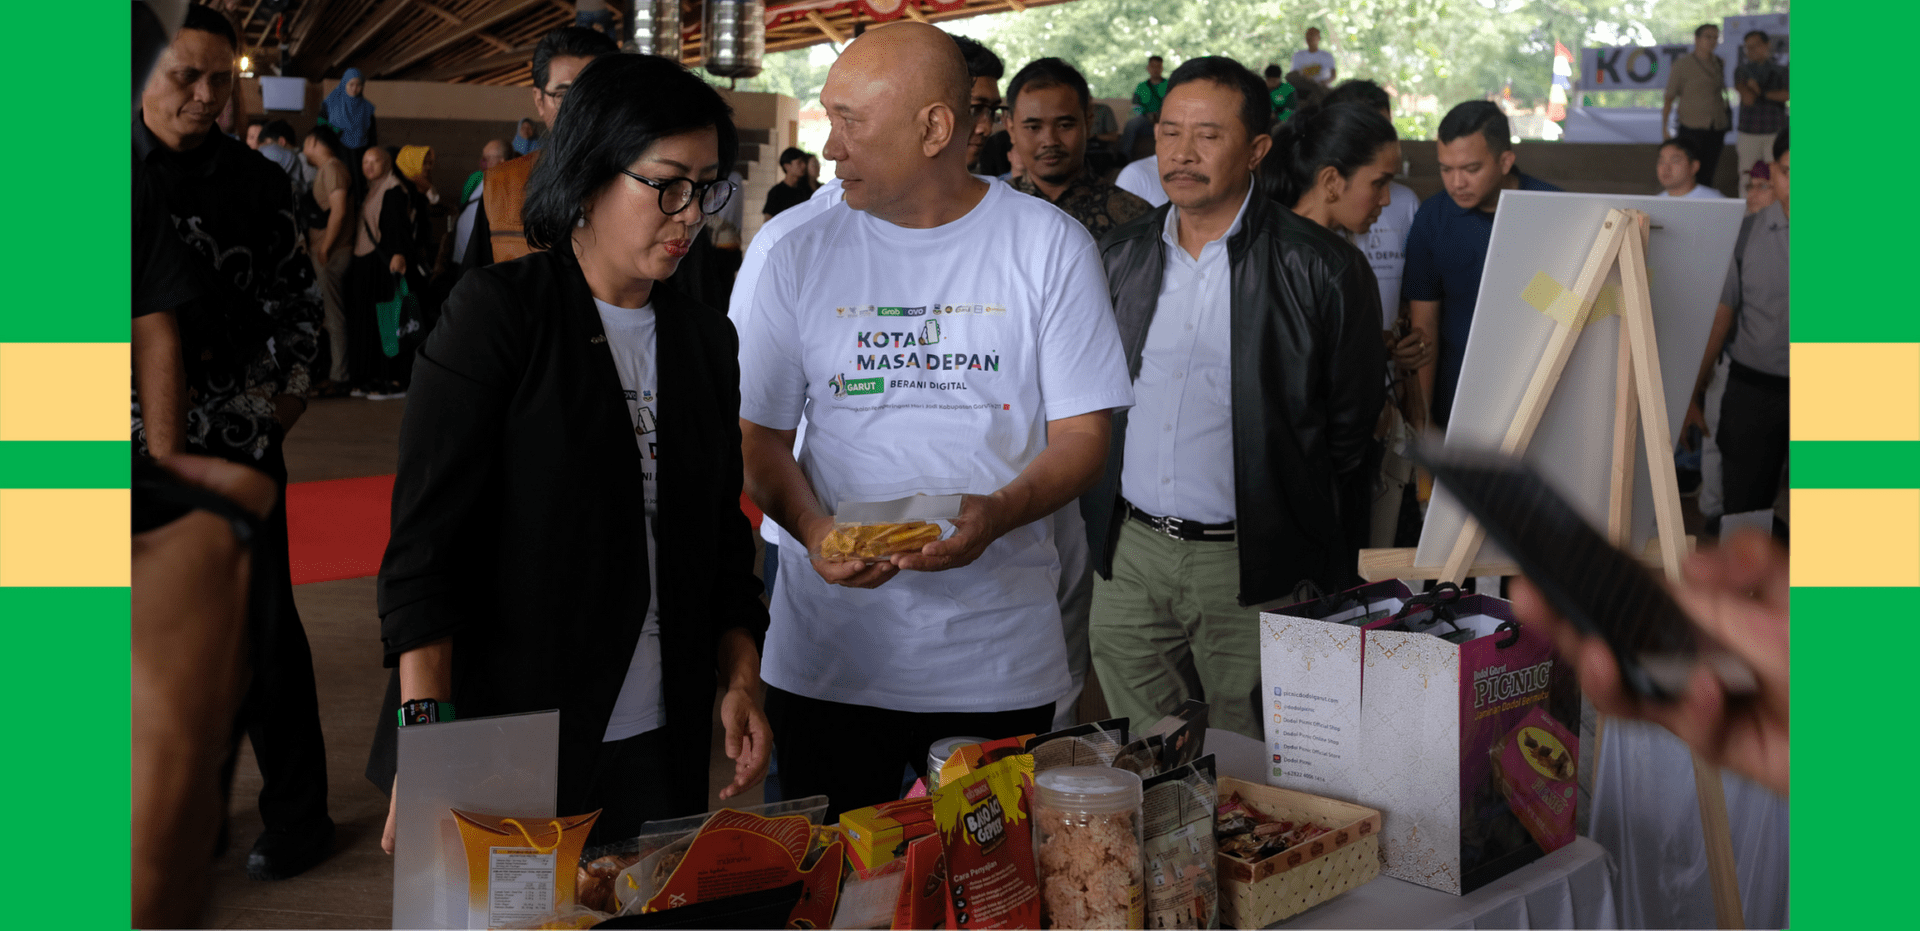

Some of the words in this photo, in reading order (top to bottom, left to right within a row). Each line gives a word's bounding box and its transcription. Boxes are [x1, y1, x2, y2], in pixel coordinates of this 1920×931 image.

[1596, 46, 1689, 83] KOT
[857, 331, 917, 348] KOTA
[857, 352, 921, 371] MASA
[926, 353, 999, 371] DEPAN
[847, 381, 876, 391] GARUT
[890, 379, 927, 389] BERANI
[929, 381, 967, 390] DIGITAL
[1473, 662, 1550, 709] PICNIC
[966, 807, 991, 832] BASO
[953, 872, 970, 883] Cara
[970, 861, 998, 877] Penyajian
